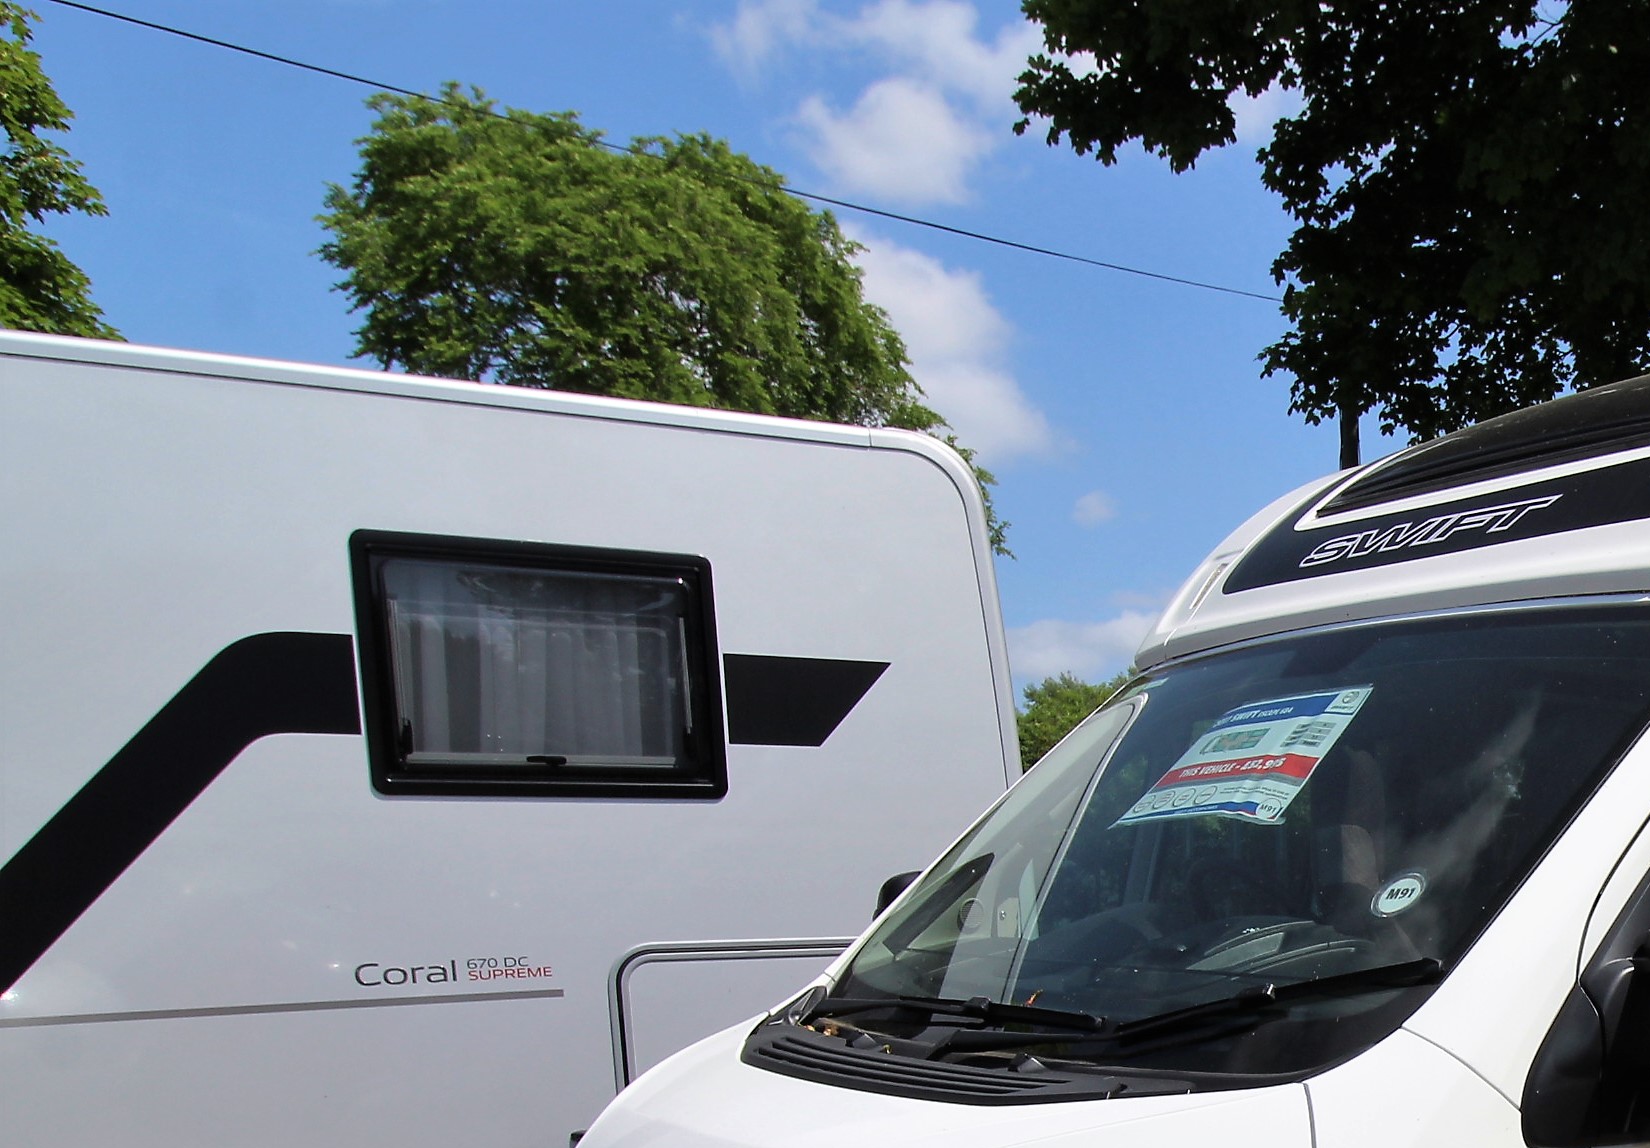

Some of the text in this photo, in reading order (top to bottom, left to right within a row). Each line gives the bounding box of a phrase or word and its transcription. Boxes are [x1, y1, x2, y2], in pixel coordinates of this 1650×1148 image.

[1299, 494, 1564, 568] SWIFT
[1198, 762, 1237, 776] VEHICLE
[1260, 804, 1277, 813] M91
[1386, 887, 1416, 900] M91
[355, 956, 529, 986] Coral 670 DC
[468, 966, 553, 981] SUPREME
